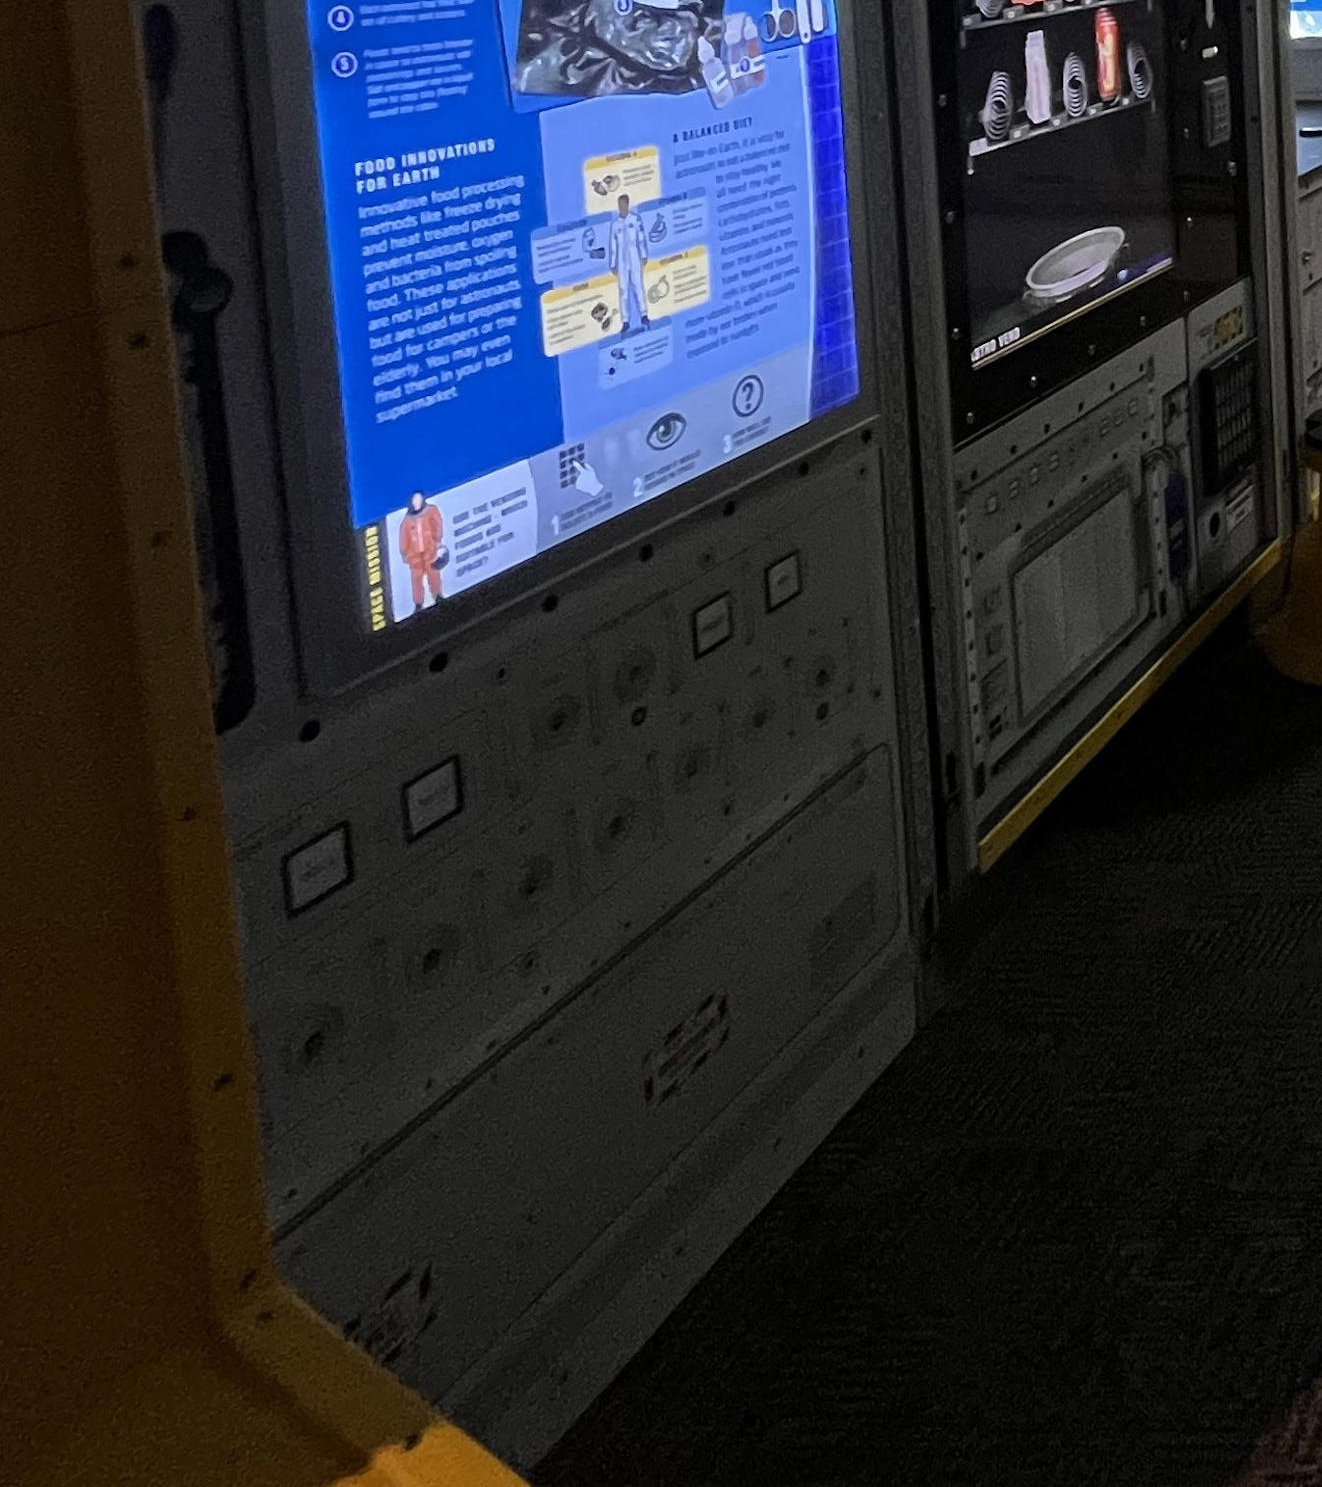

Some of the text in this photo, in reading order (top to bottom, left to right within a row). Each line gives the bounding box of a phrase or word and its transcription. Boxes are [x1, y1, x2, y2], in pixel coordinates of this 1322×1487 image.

[355, 138, 495, 177] FOOD INNOVATIONS
[356, 165, 440, 194] FOR EARTH
[362, 239, 388, 256] and
[366, 276, 390, 294] and
